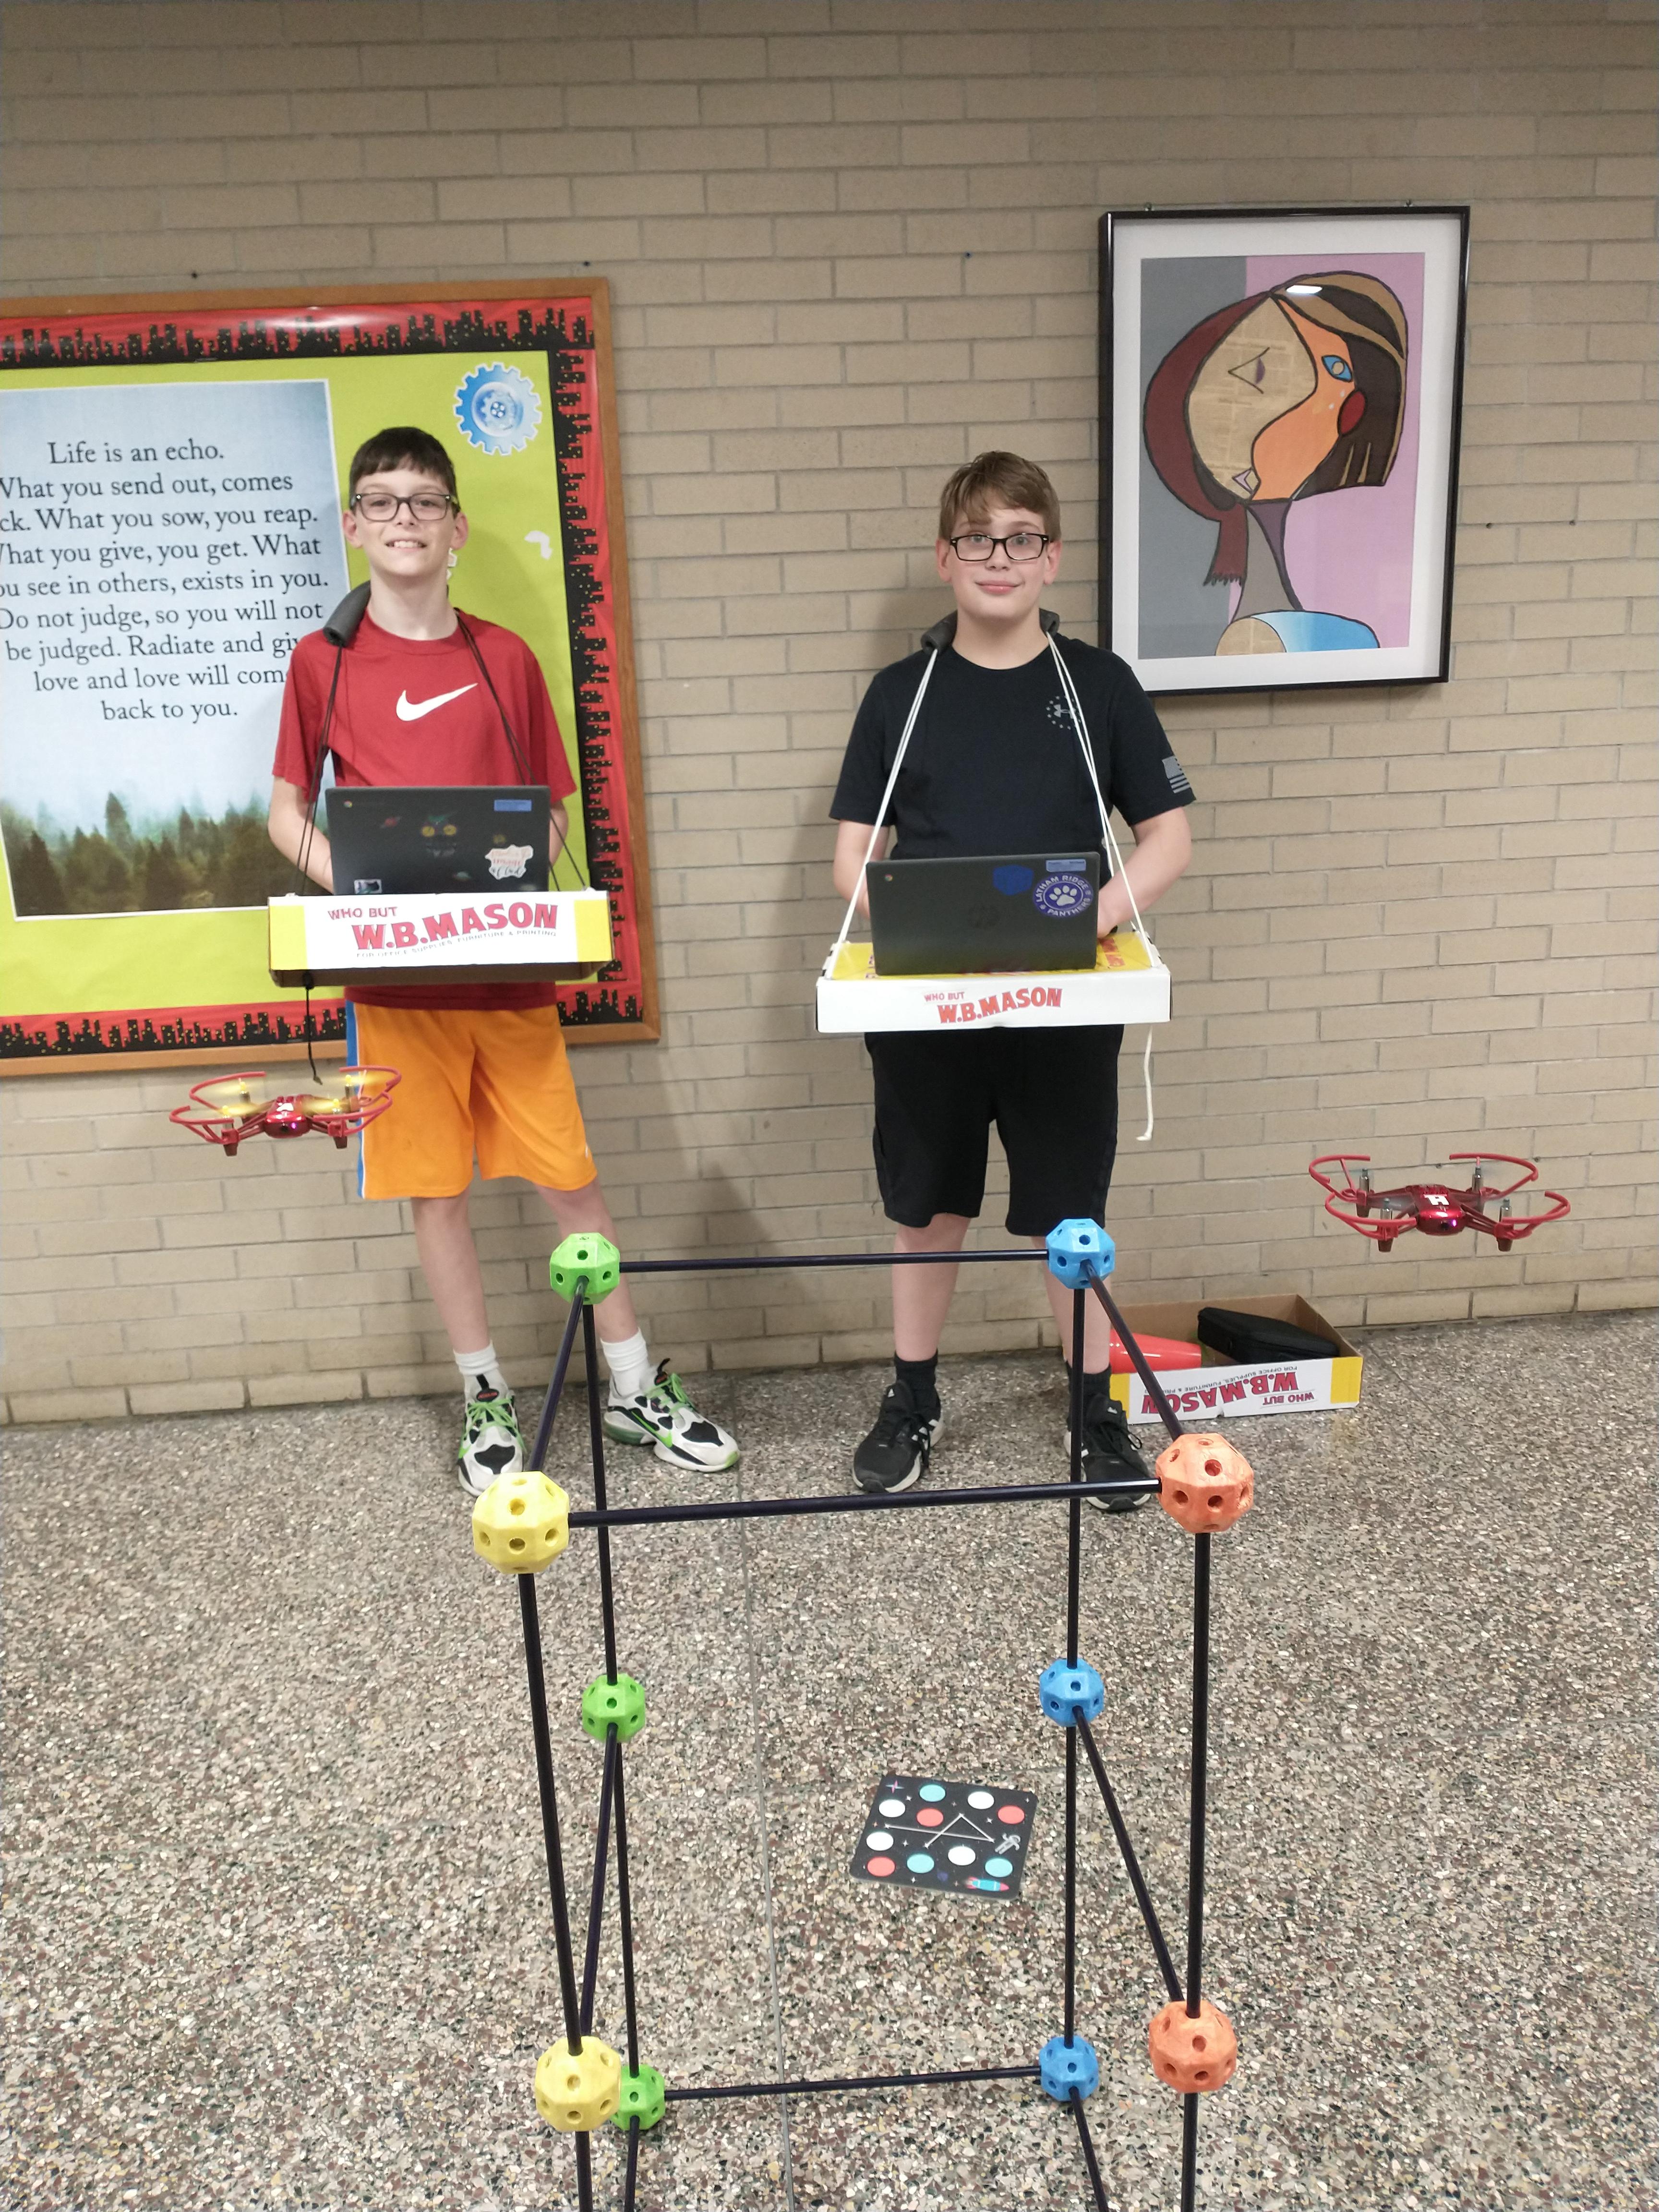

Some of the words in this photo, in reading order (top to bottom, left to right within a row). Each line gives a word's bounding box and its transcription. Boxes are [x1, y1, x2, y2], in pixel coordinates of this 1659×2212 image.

[47, 441, 96, 464] Life
[104, 443, 122, 462] is
[131, 448, 158, 461] an
[165, 438, 224, 460] echo.
[61, 482, 104, 504] you
[111, 472, 164, 495] send
[172, 477, 216, 496] out,
[222, 476, 293, 492] comes
[0, 510, 31, 532] ck.
[34, 508, 105, 529] What
[111, 514, 154, 534] you
[161, 512, 209, 529] sow,
[214, 510, 256, 530] you
[264, 508, 318, 530] reap.
[0, 543, 44, 565] hat
[50, 548, 91, 570] you
[99, 541, 152, 568] give,
[156, 545, 199, 566] you
[206, 541, 248, 565] get.
[251, 534, 321, 556] What
[27, 582, 60, 596] see
[67, 575, 91, 594] in
[98, 571, 176, 595] others,
[182, 571, 243, 590] exists
[251, 569, 274, 588] in
[280, 573, 328, 594] you.
[0, 608, 28, 629] Do
[37, 612, 74, 628] not
[81, 604, 150, 632] judge,
[156, 610, 179, 624] so
[186, 609, 228, 629] you
[234, 599, 277, 620] will
[285, 603, 324, 619] not
[5, 640, 32, 660] be
[39, 636, 121, 667] judged.
[128, 634, 215, 656] Radiate
[223, 631, 264, 653] and
[34, 671, 79, 691] love
[87, 668, 128, 689] and
[134, 667, 180, 687] love
[186, 664, 229, 685] will
[237, 670, 286, 684] com
[100, 699, 156, 720] back
[161, 704, 183, 718] to
[191, 703, 237, 724] you.
[1035, 876, 1059, 902] LATHAM
[1062, 875, 1089, 890] RIDGE
[328, 908, 362, 921] WHO
[369, 906, 397, 918] BUT
[351, 902, 558, 950] W.B.MASON
[925, 993, 945, 1002] WHO
[948, 991, 965, 1000] BUT
[937, 986, 1063, 1024] W.B.MASON
[1185, 1381, 1222, 1393] FURNITURE
[1262, 1395, 1285, 1406] BUT
[1288, 1392, 1314, 1404] WHO
